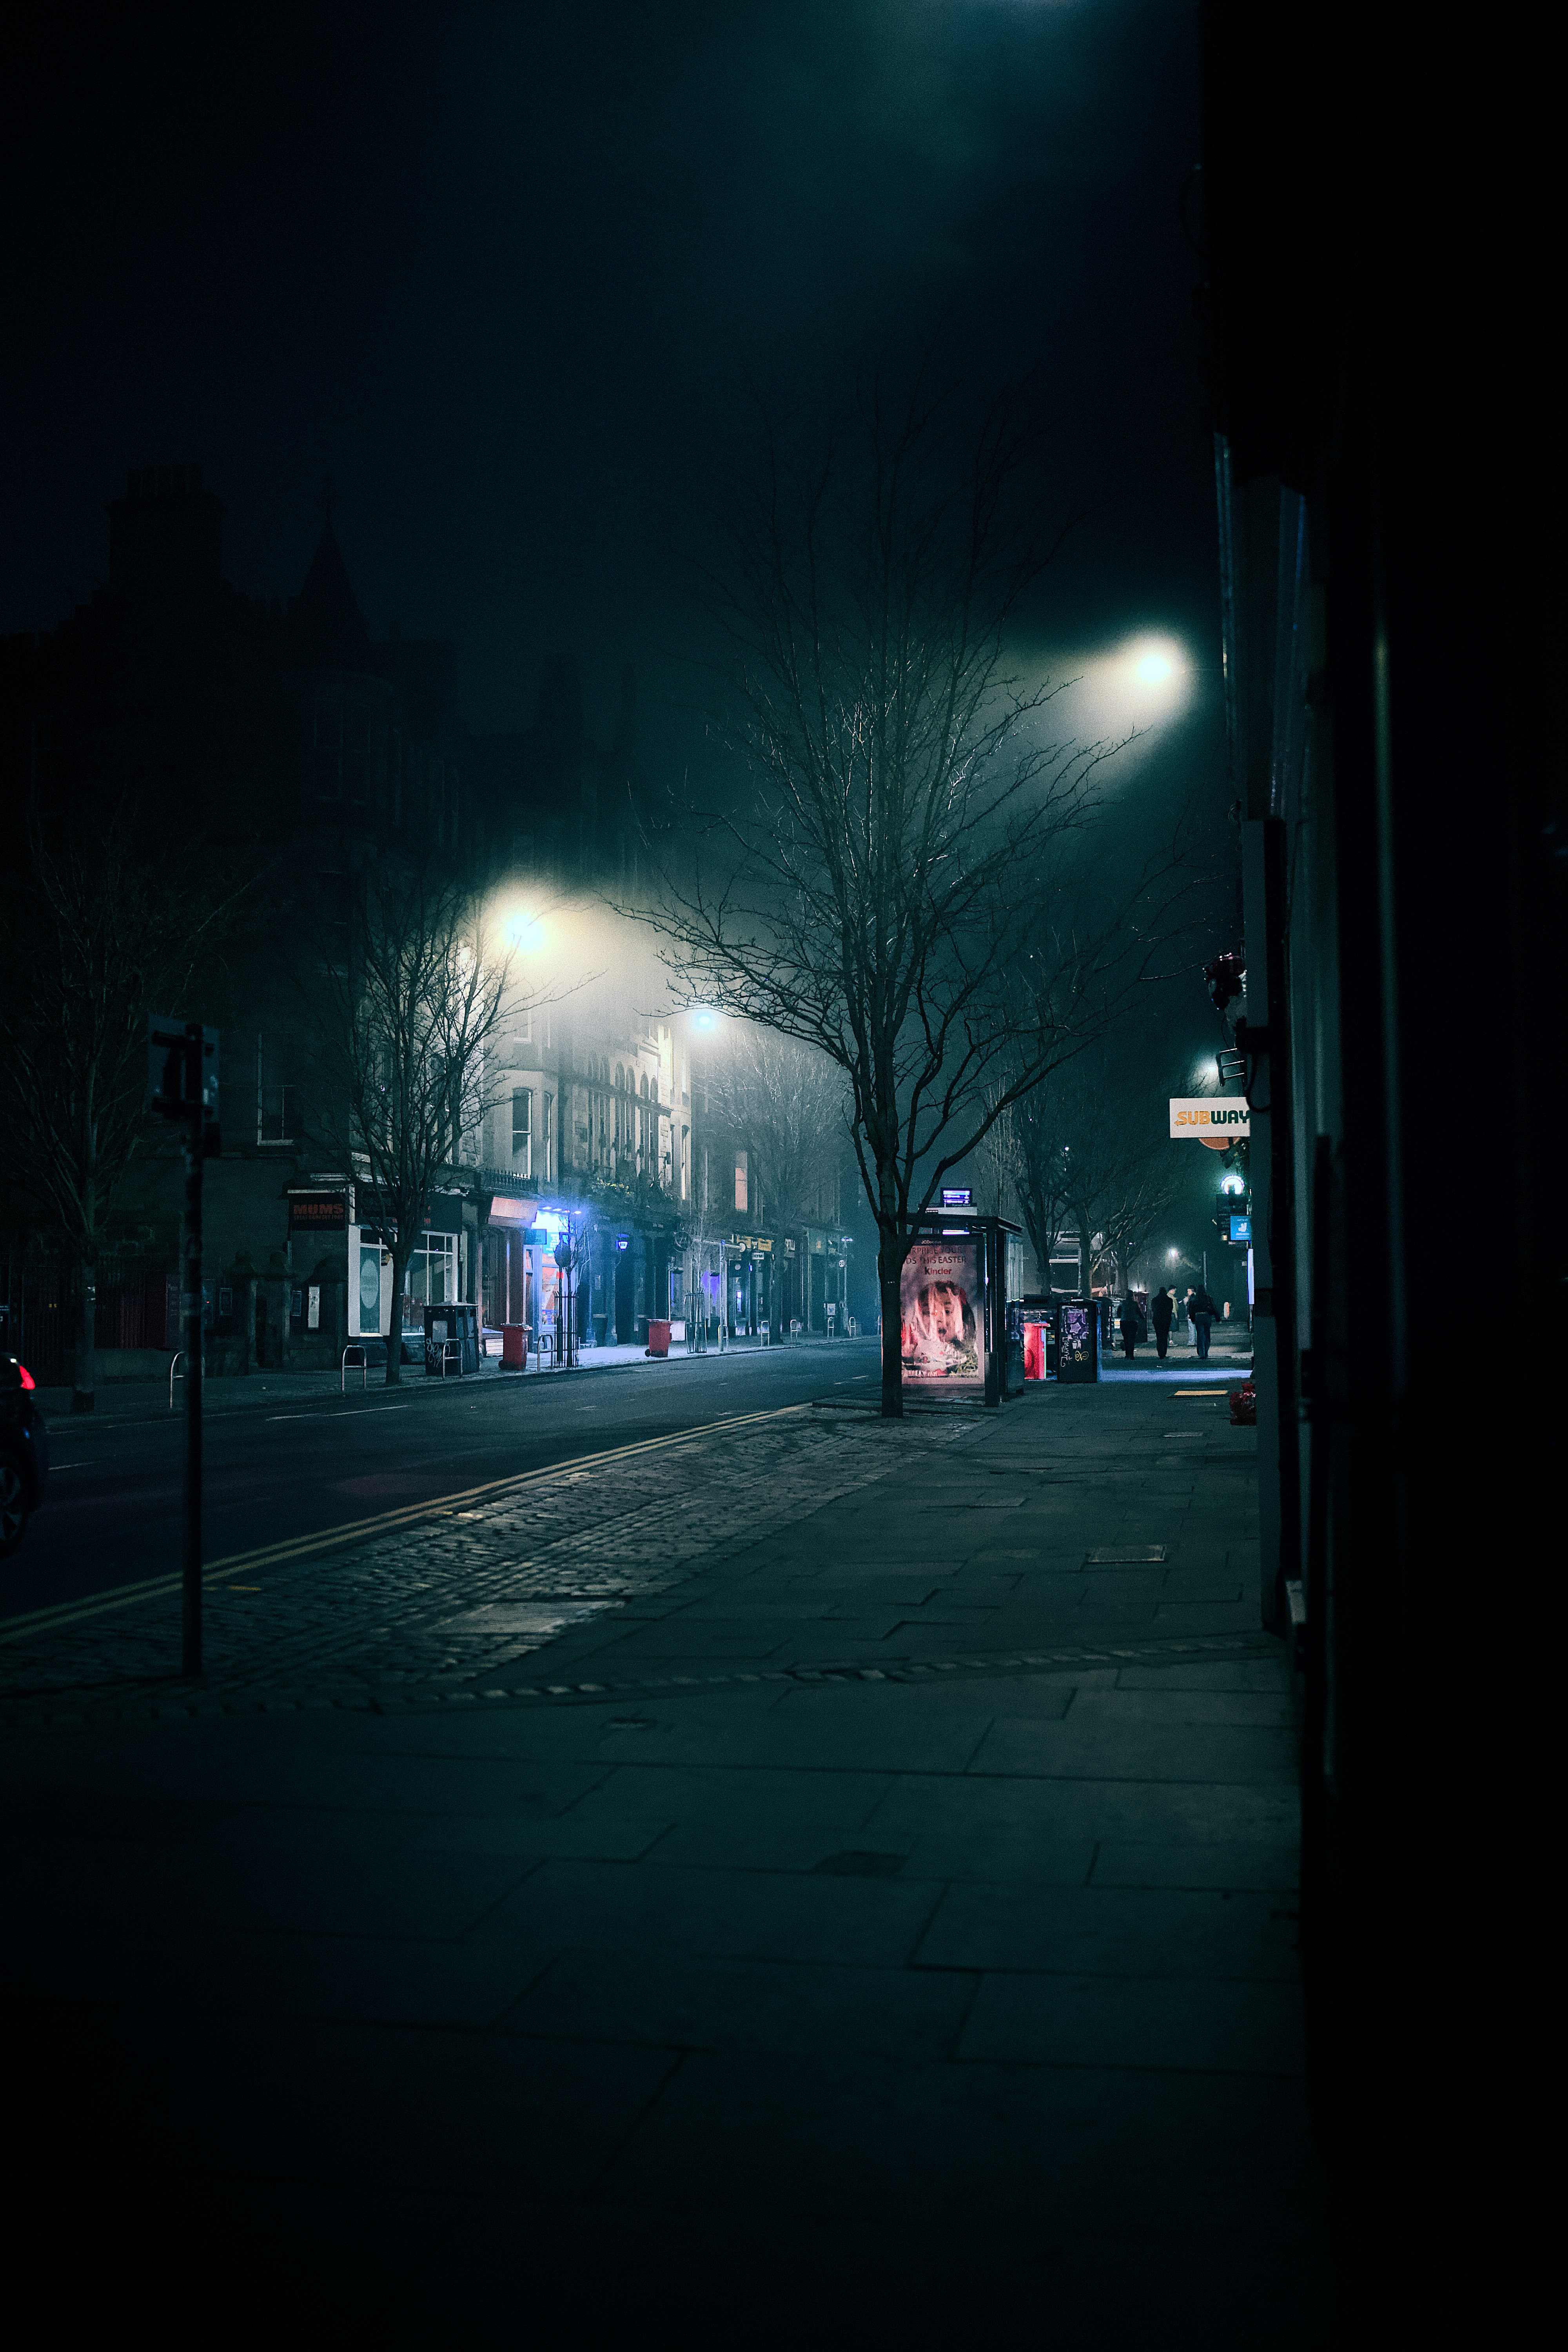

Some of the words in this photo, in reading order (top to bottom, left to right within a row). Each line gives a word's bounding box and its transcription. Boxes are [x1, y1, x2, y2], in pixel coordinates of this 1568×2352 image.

[1174, 1110, 1250, 1126] SUBWAY
[294, 1203, 344, 1214] MUMS
[938, 1255, 966, 1263] EASTER
[924, 1267, 952, 1275] Kinder
